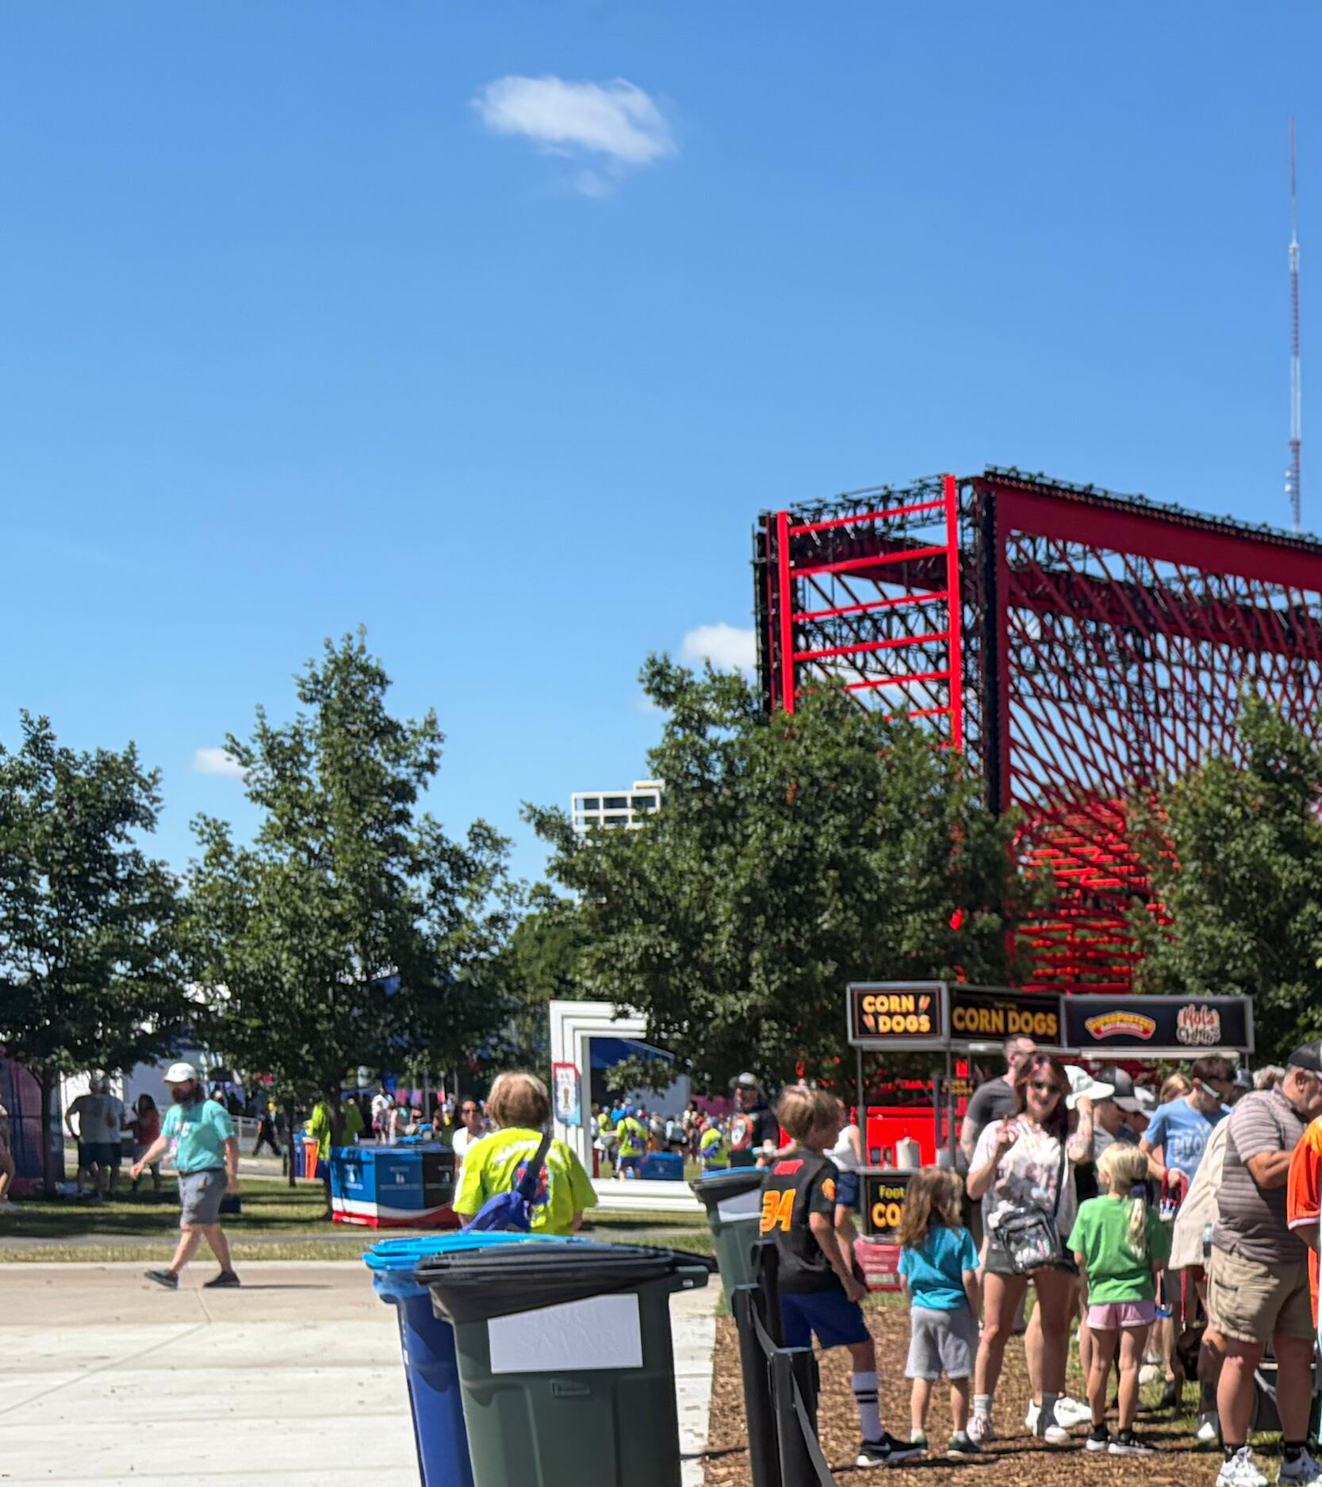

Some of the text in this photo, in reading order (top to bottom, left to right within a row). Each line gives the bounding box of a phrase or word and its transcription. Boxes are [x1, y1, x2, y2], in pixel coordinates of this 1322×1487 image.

[862, 995, 915, 1013] CORN
[878, 1014, 931, 1033] DOGS
[952, 1006, 1004, 1033] CORN
[1008, 1010, 1058, 1036] DOGS
[872, 1203, 902, 1228] CO
